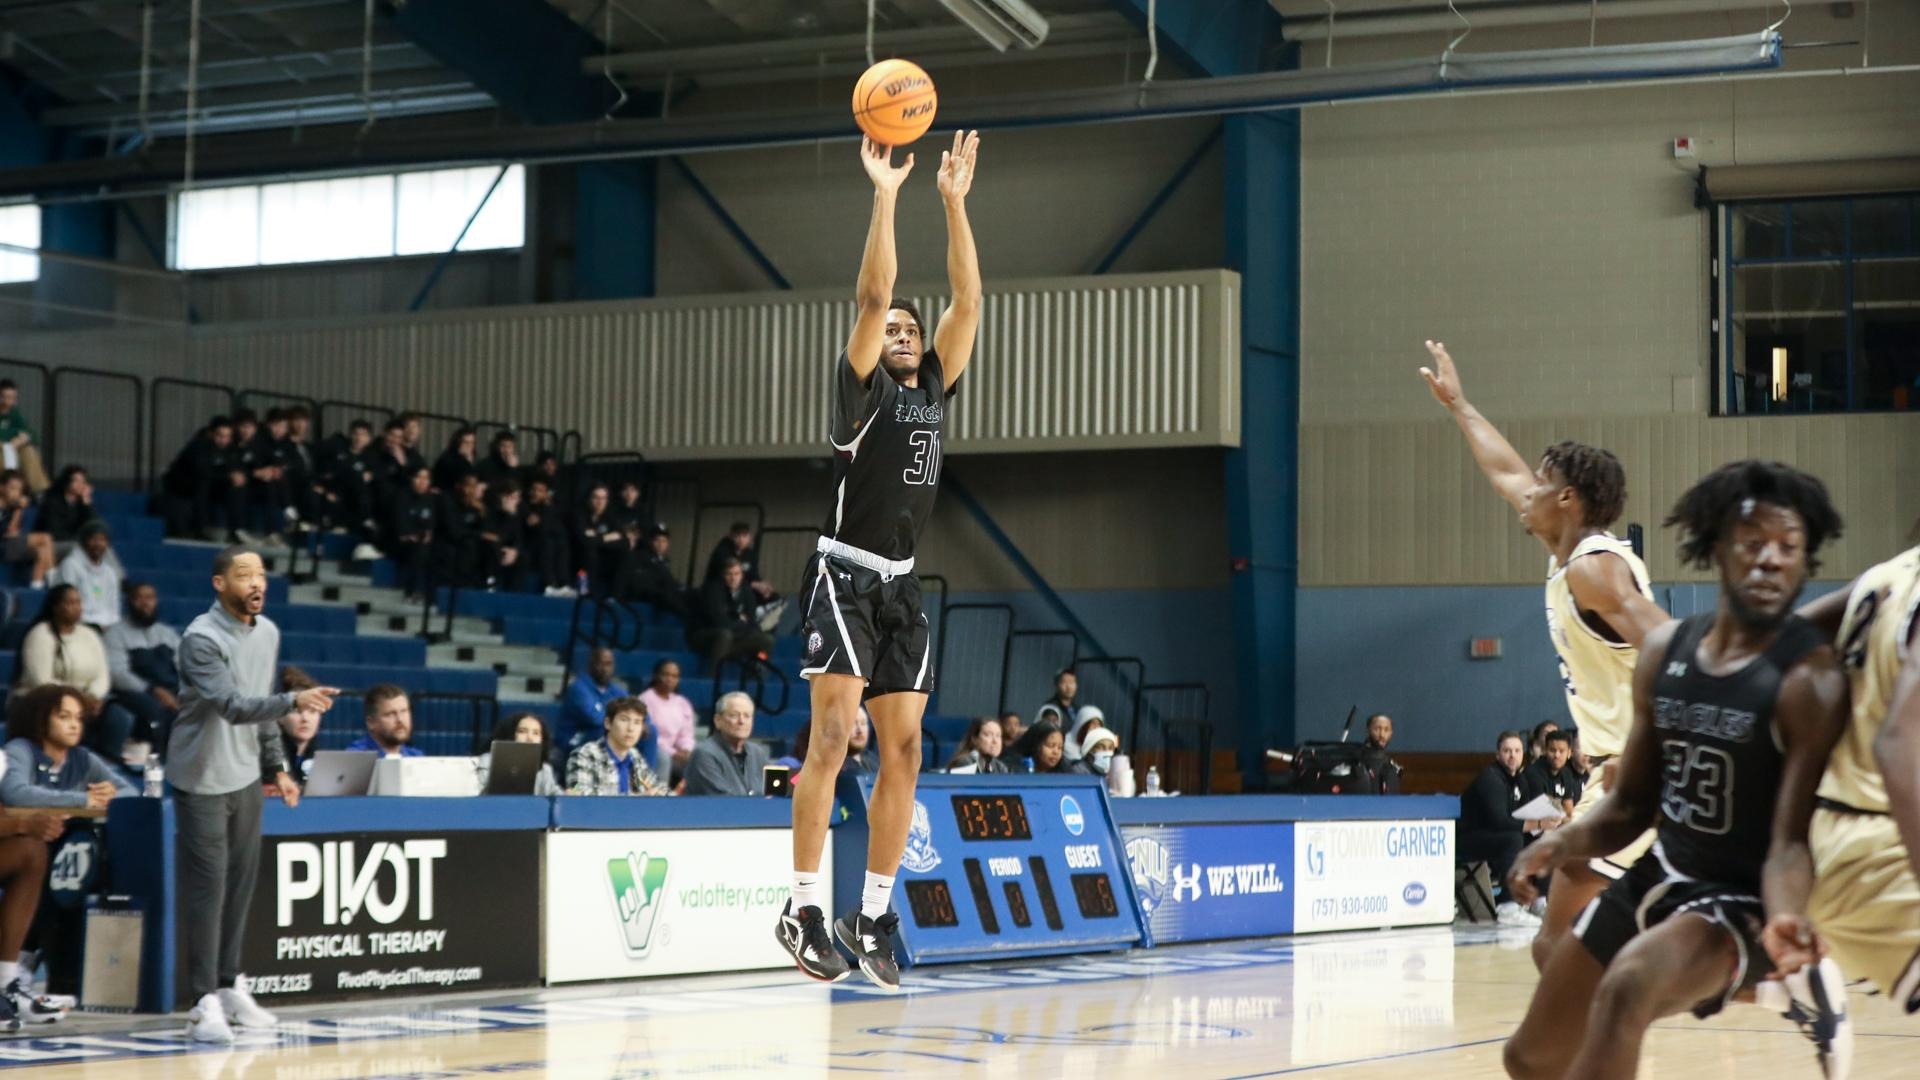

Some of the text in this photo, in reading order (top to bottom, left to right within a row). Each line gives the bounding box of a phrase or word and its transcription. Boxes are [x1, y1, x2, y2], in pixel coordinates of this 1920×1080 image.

[902, 101, 933, 120] NCAA
[903, 430, 940, 485] 31
[962, 799, 1028, 838] 13:31
[988, 857, 1023, 877] PERIOD
[1064, 845, 1102, 869] GUEST
[276, 839, 447, 927] PIVOT
[1206, 863, 1284, 897] WE WILL.
[678, 883, 791, 912] valottery.com
[1311, 896, 1389, 921] (757) 930-0000
[276, 929, 448, 961] PHYSICAL THERAPY
[337, 966, 483, 990] PivotPhysicalTherapy.com
